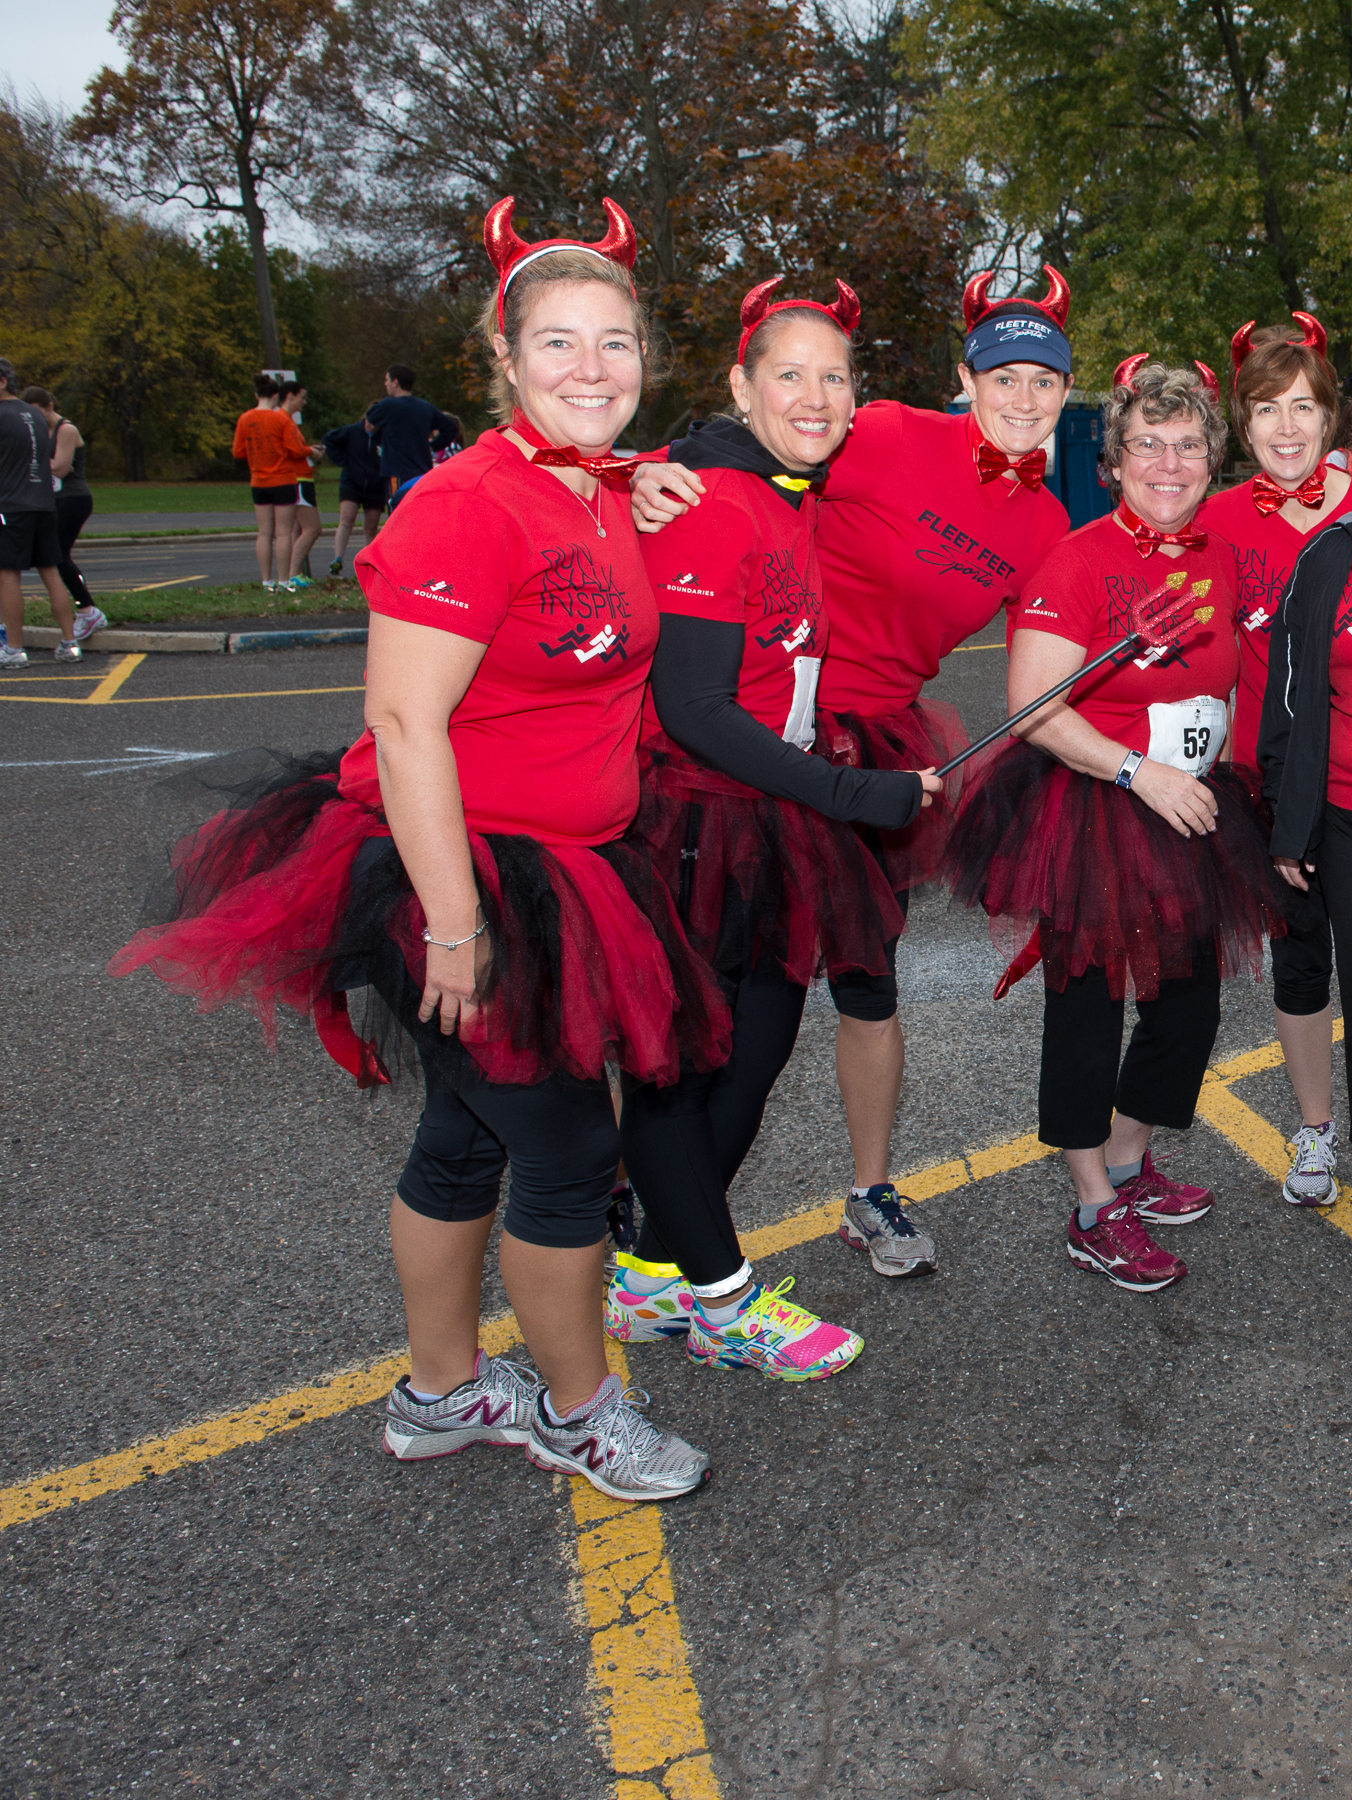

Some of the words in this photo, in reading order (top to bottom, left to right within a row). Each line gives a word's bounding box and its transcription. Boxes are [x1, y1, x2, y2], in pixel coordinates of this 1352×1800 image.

[995, 320, 1027, 331] FLEET
[1028, 321, 1052, 335] FEET
[540, 541, 593, 569] RUN
[917, 509, 979, 554] FLEET
[976, 547, 1016, 581] FEET
[915, 544, 999, 588] Sports
[413, 589, 469, 609] BOUNDARIES
[667, 584, 715, 597] BOUNDARIES
[1104, 574, 1150, 601] RUN
[540, 588, 631, 619] INSPIRE
[1024, 608, 1058, 618] BOUNDARIES
[1183, 726, 1211, 759] 53
